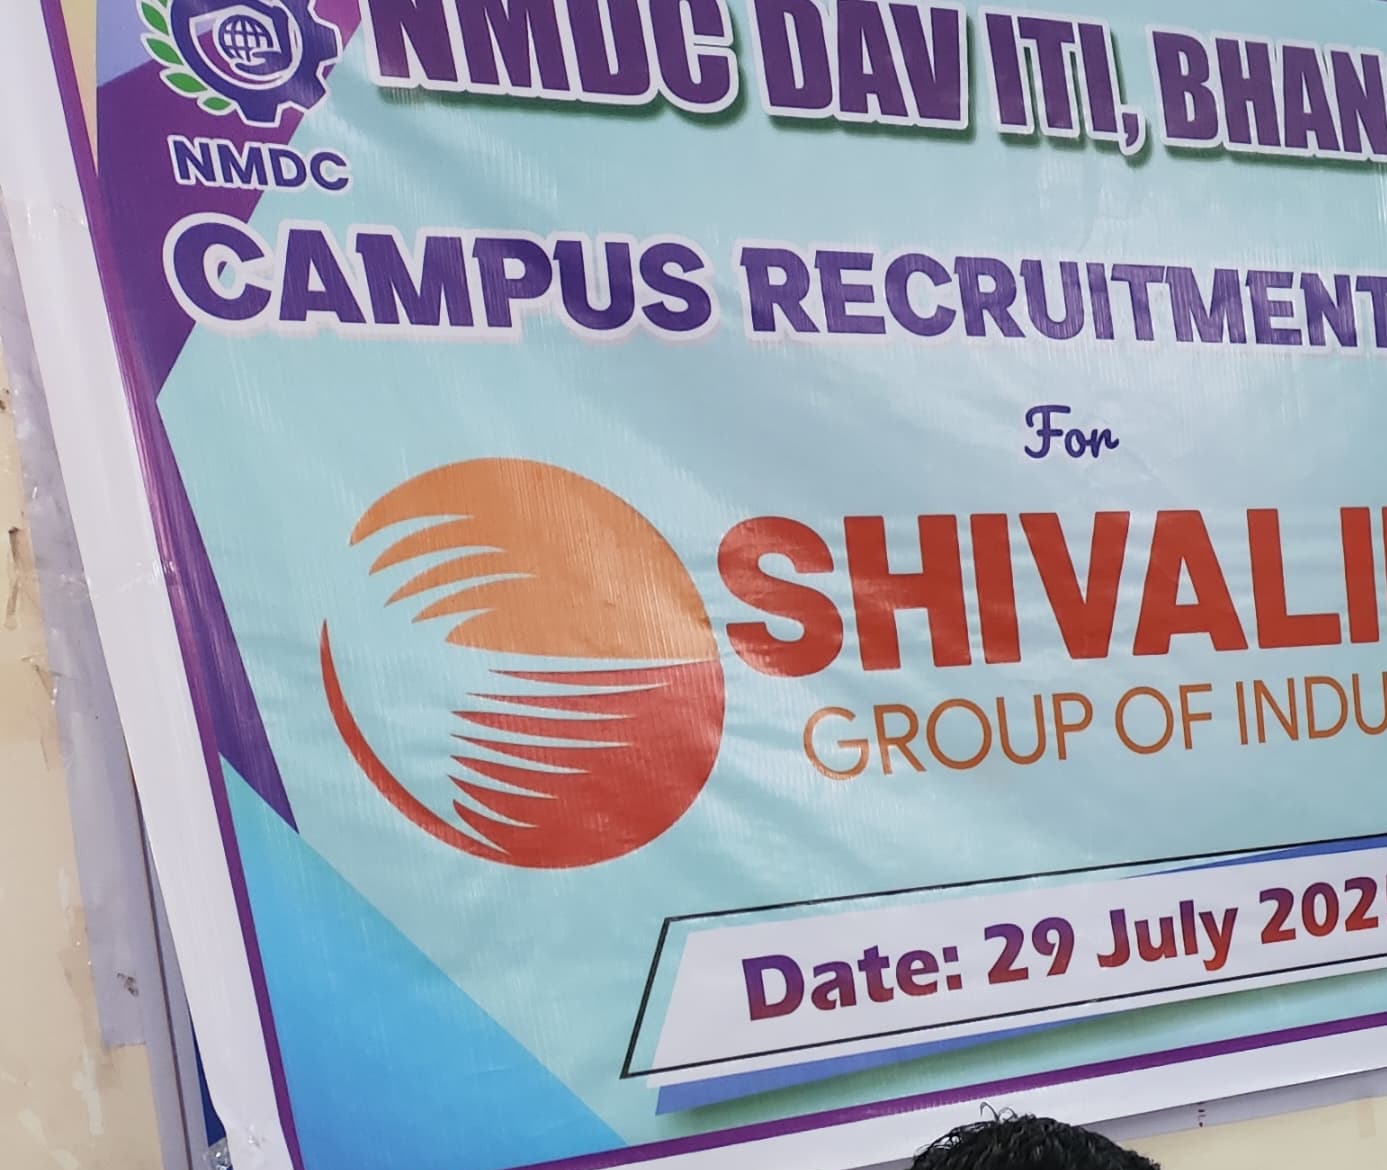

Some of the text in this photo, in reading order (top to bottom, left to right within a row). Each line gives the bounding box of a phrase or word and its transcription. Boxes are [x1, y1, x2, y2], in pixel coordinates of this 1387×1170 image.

[367, 0, 732, 105] NMDC
[757, 0, 962, 122] DAV
[987, 6, 1141, 147] ITI,
[172, 139, 350, 191] NMDC
[173, 221, 713, 332] CAMPUS
[1024, 404, 1120, 459] For
[802, 692, 1094, 780] GROUP
[1114, 682, 1212, 756] OF
[741, 944, 962, 1022] Date:
[982, 915, 1075, 985] 29
[1096, 896, 1239, 973] July
